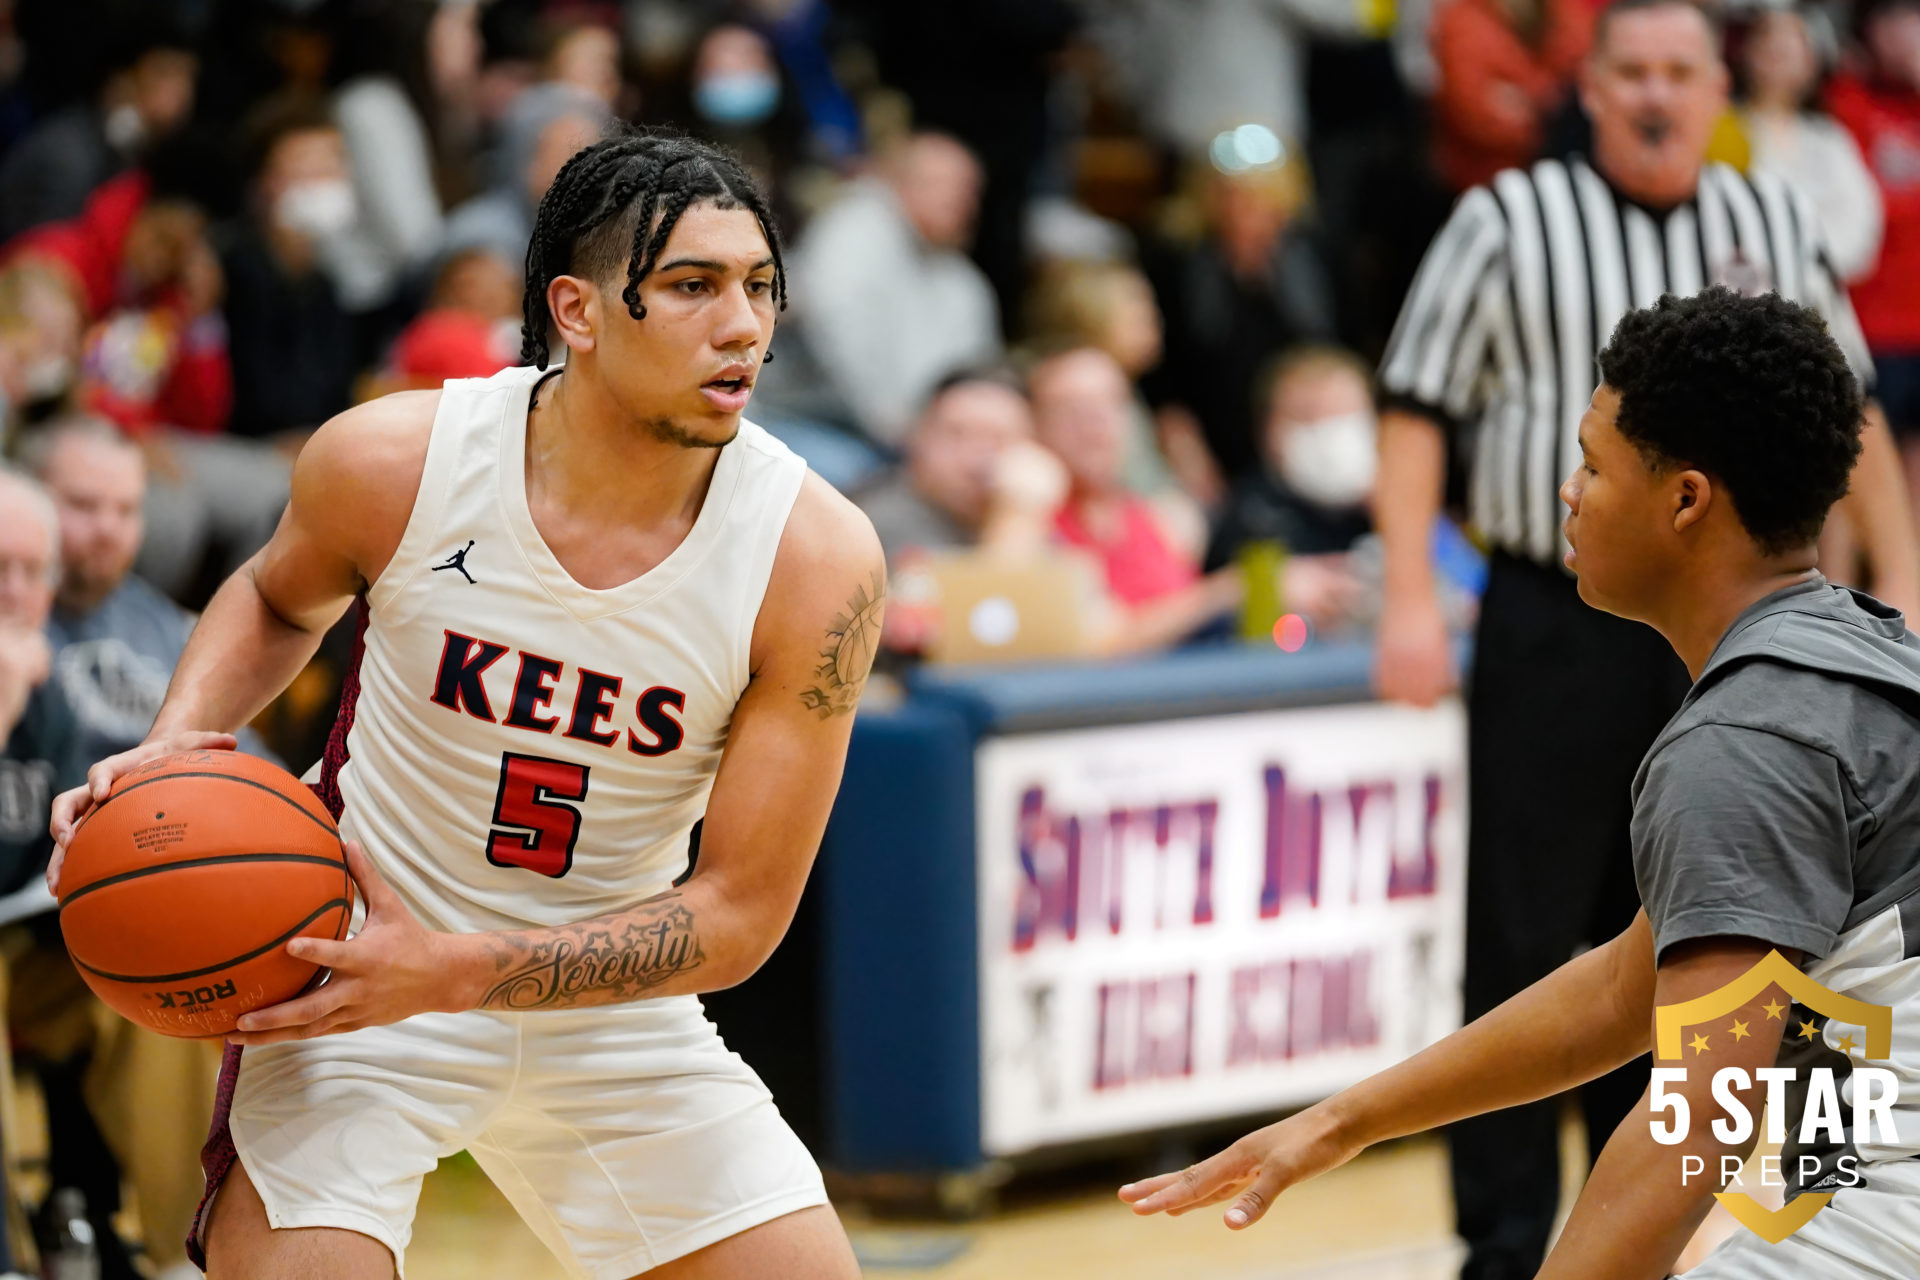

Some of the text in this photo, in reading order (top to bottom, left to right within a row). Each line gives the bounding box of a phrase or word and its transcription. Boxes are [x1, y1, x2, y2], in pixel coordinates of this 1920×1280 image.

[430, 629, 686, 757] KEES
[485, 751, 591, 878] 5
[155, 978, 237, 1008] ROCK
[478, 920, 701, 1009] Serenity
[187, 1004, 213, 1015] THE
